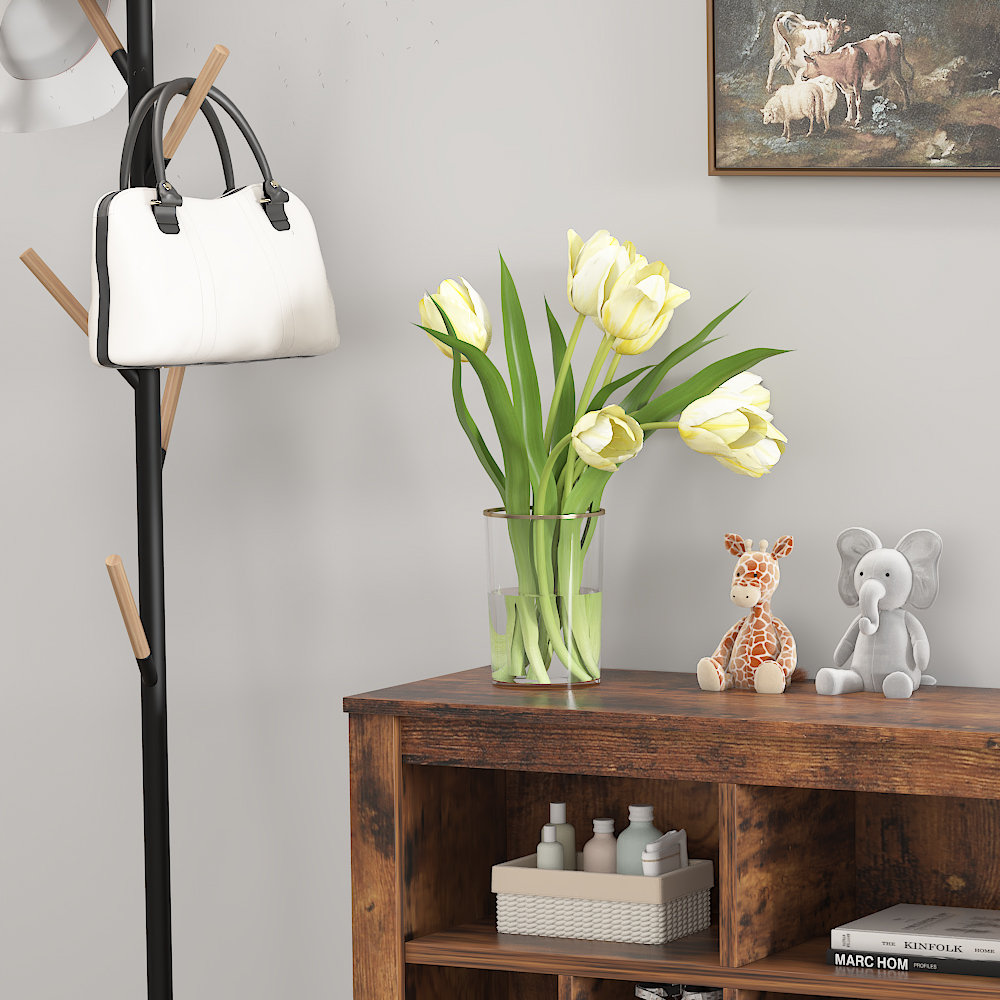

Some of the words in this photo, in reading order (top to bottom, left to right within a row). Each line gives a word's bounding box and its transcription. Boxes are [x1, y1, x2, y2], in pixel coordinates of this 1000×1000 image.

[904, 941, 963, 953] KINFOLK
[834, 953, 875, 968] MARC
[877, 956, 909, 971] HOM
[913, 962, 938, 970] PROFILES
